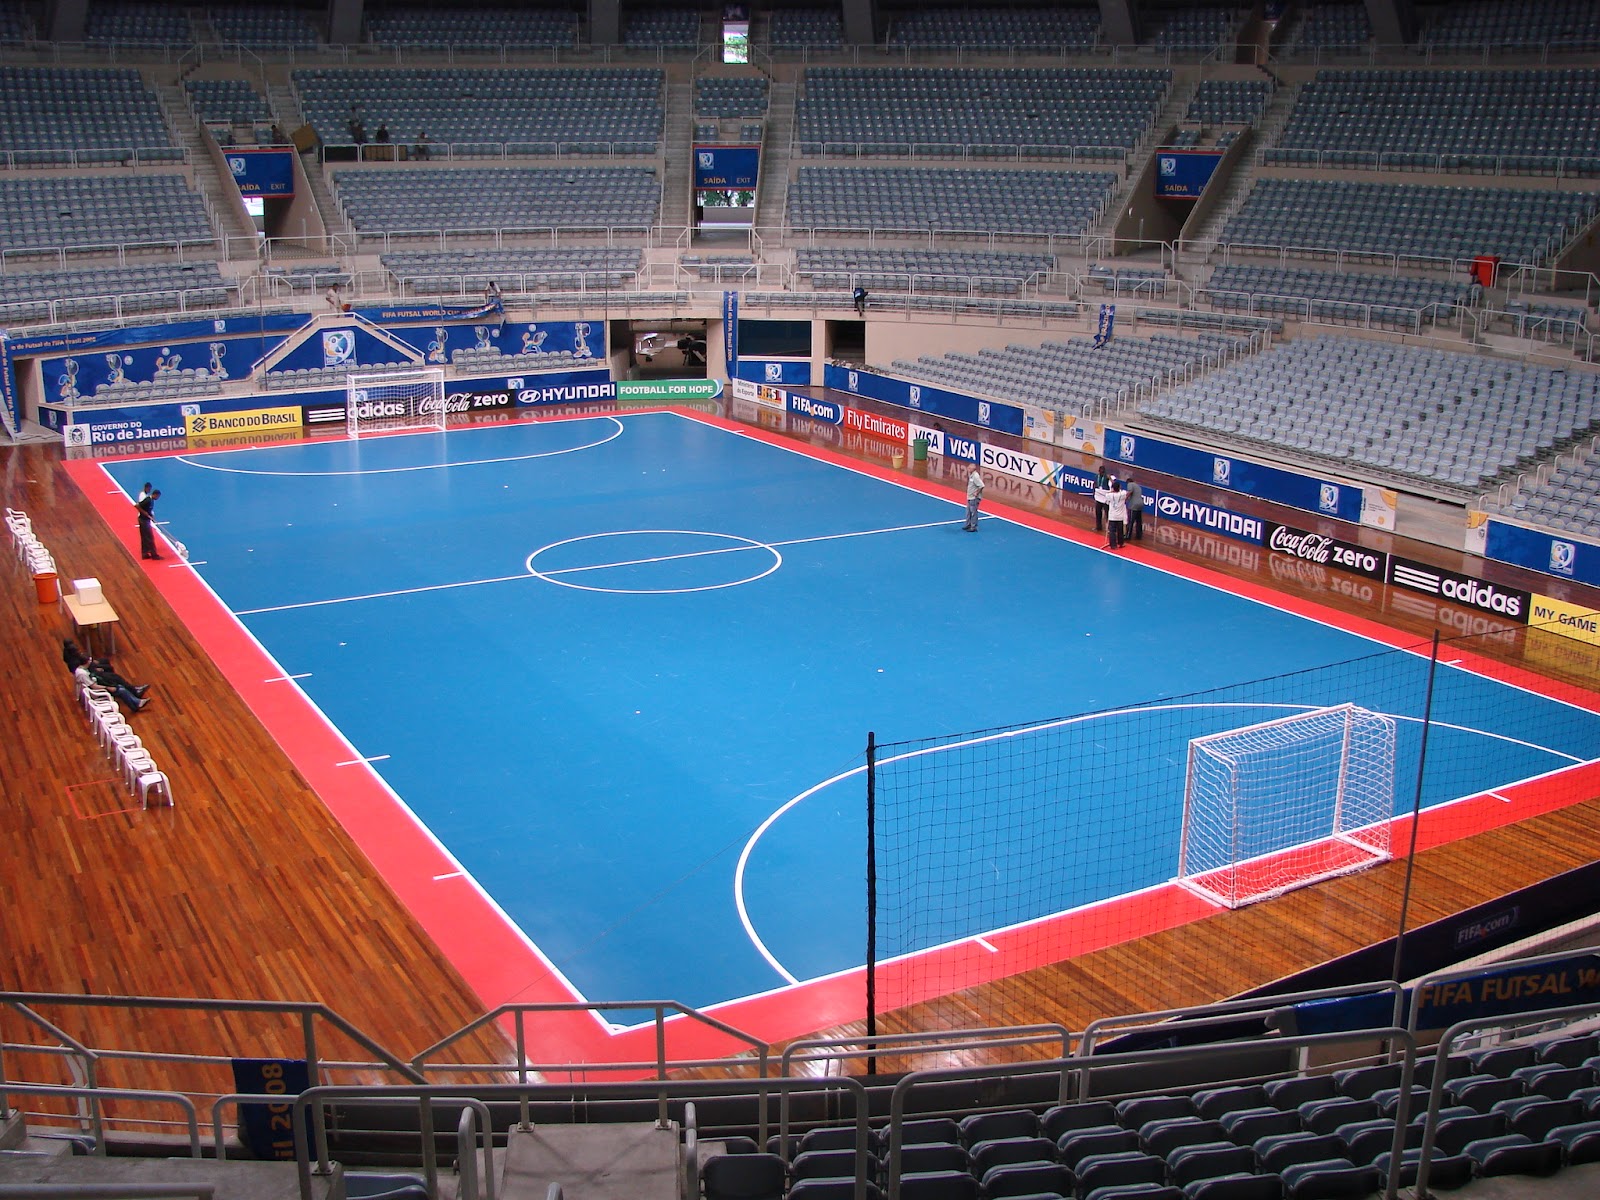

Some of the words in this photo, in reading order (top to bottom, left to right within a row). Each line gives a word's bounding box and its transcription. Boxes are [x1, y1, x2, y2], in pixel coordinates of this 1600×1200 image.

[704, 176, 726, 184] SAÍDA
[1164, 183, 1188, 192] SAÍDA
[474, 394, 508, 407] zero
[542, 384, 616, 401] HYUNDAI
[620, 386, 667, 395] FOOTBALL
[669, 386, 687, 394] FOR
[689, 385, 714, 393] HOPE
[348, 402, 405, 418] adidas
[792, 396, 834, 419] FIFA.com
[92, 423, 128, 431] GOVERNO
[210, 418, 245, 429] BANCO
[248, 416, 260, 426] DO
[262, 413, 297, 425] BRASIL
[847, 410, 862, 430] Fly
[864, 414, 905, 439] Emirates
[92, 430, 114, 442] Rio
[117, 429, 135, 440] de
[136, 426, 185, 438] Janeiro
[913, 428, 938, 449] VISA
[948, 437, 976, 460] VISA
[983, 449, 1038, 476] SONY
[1064, 474, 1080, 486] FIFA
[1081, 478, 1094, 489] FUT
[1141, 495, 1154, 506] UP
[1182, 501, 1262, 540] HYUNDAI
[1270, 526, 1332, 564] Coca-Cola
[1333, 546, 1376, 572] zero
[1442, 579, 1520, 616] adidas
[1534, 606, 1555, 620] MY
[1559, 614, 1597, 633] GAME
[1458, 914, 1510, 943] FIFA.com
[1418, 982, 1473, 1009] FIFA
[1480, 971, 1572, 1002] FUTSAL
[262, 1063, 292, 1131] 2008
